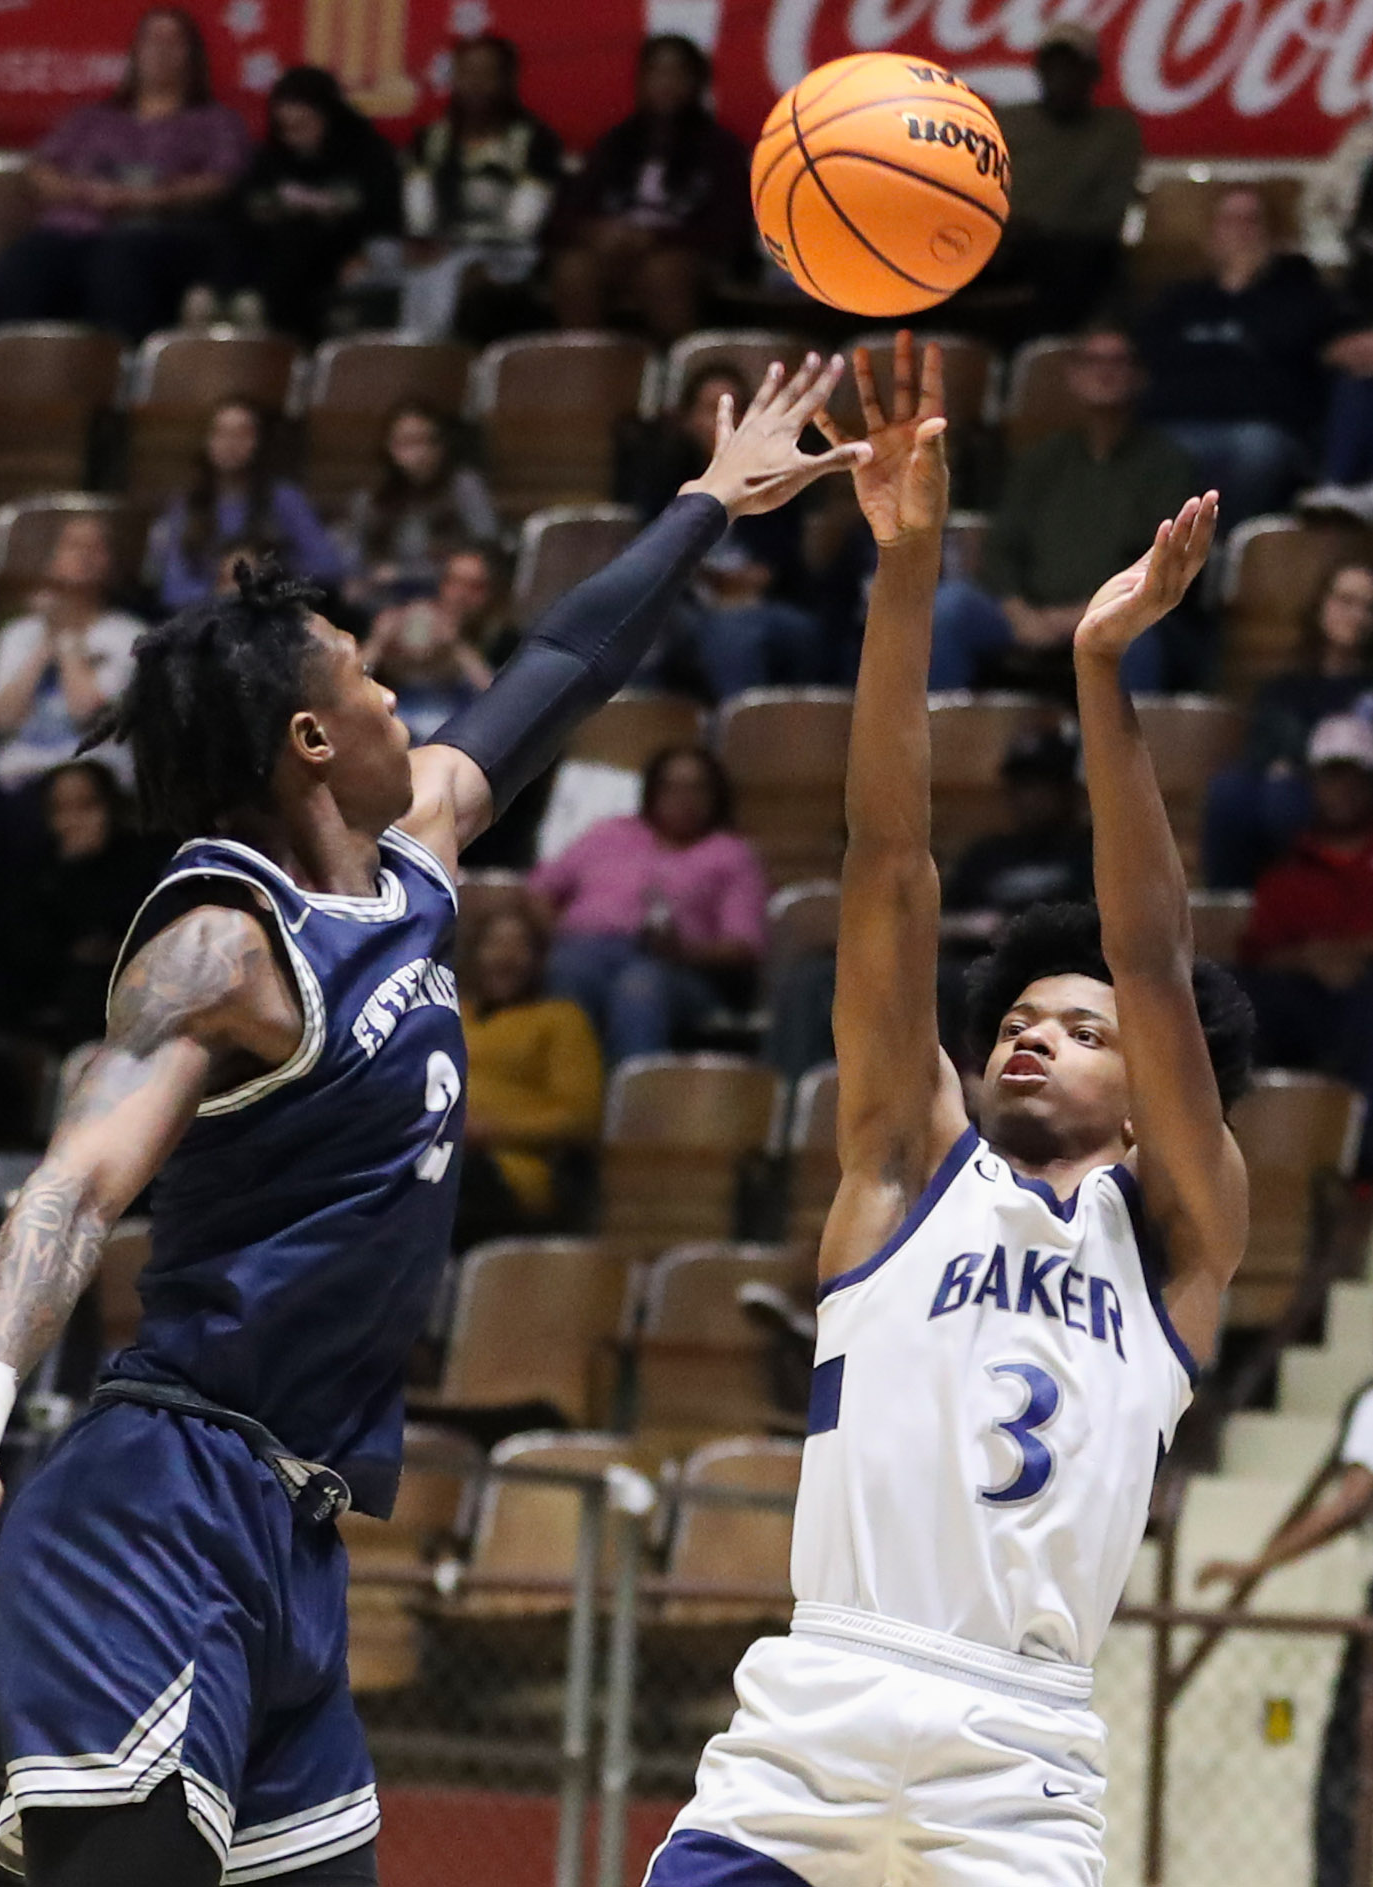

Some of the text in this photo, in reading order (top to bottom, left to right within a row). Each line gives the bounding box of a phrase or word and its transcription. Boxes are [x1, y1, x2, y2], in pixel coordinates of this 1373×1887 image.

[414, 1050, 461, 1184] 2
[928, 1244, 1127, 1364] BAKER
[975, 1358, 1065, 1509] 3
